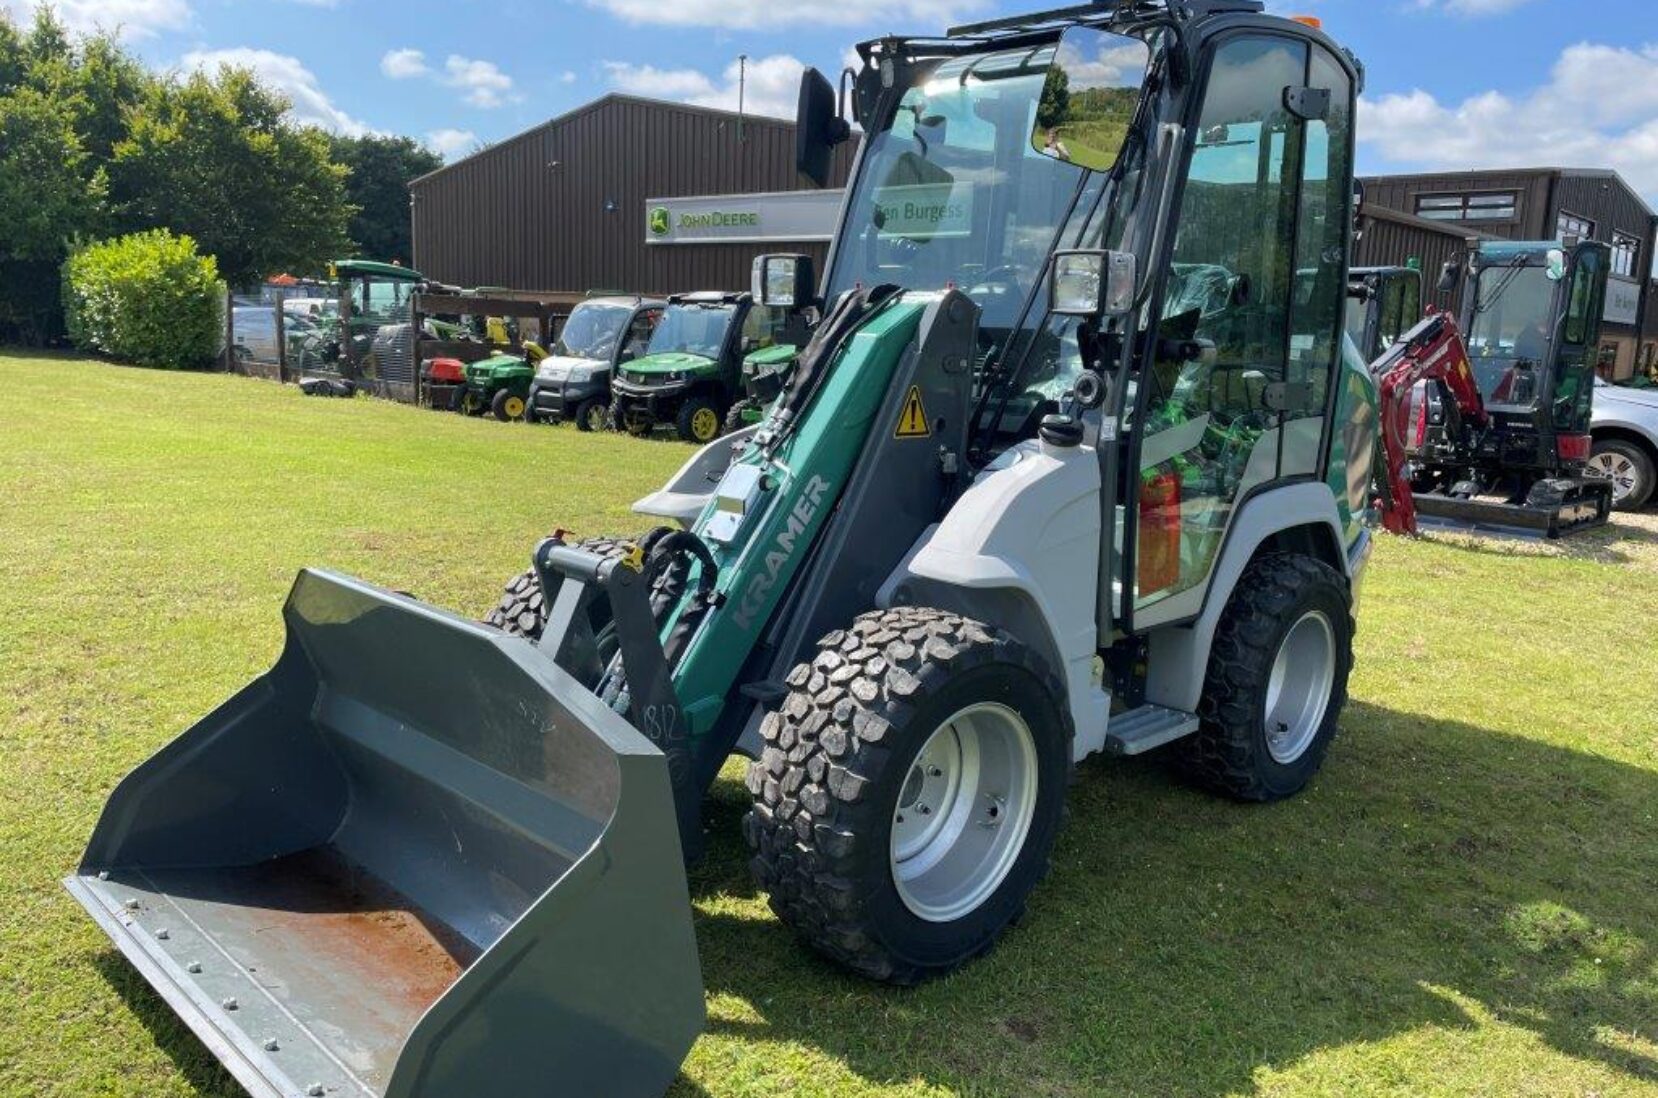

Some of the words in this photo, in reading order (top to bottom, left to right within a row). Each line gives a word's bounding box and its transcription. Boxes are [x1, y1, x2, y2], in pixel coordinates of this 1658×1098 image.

[676, 212, 710, 228] JOHN
[711, 210, 759, 227] DEERE
[904, 201, 963, 223] Burgess
[732, 474, 831, 631] KRAMER
